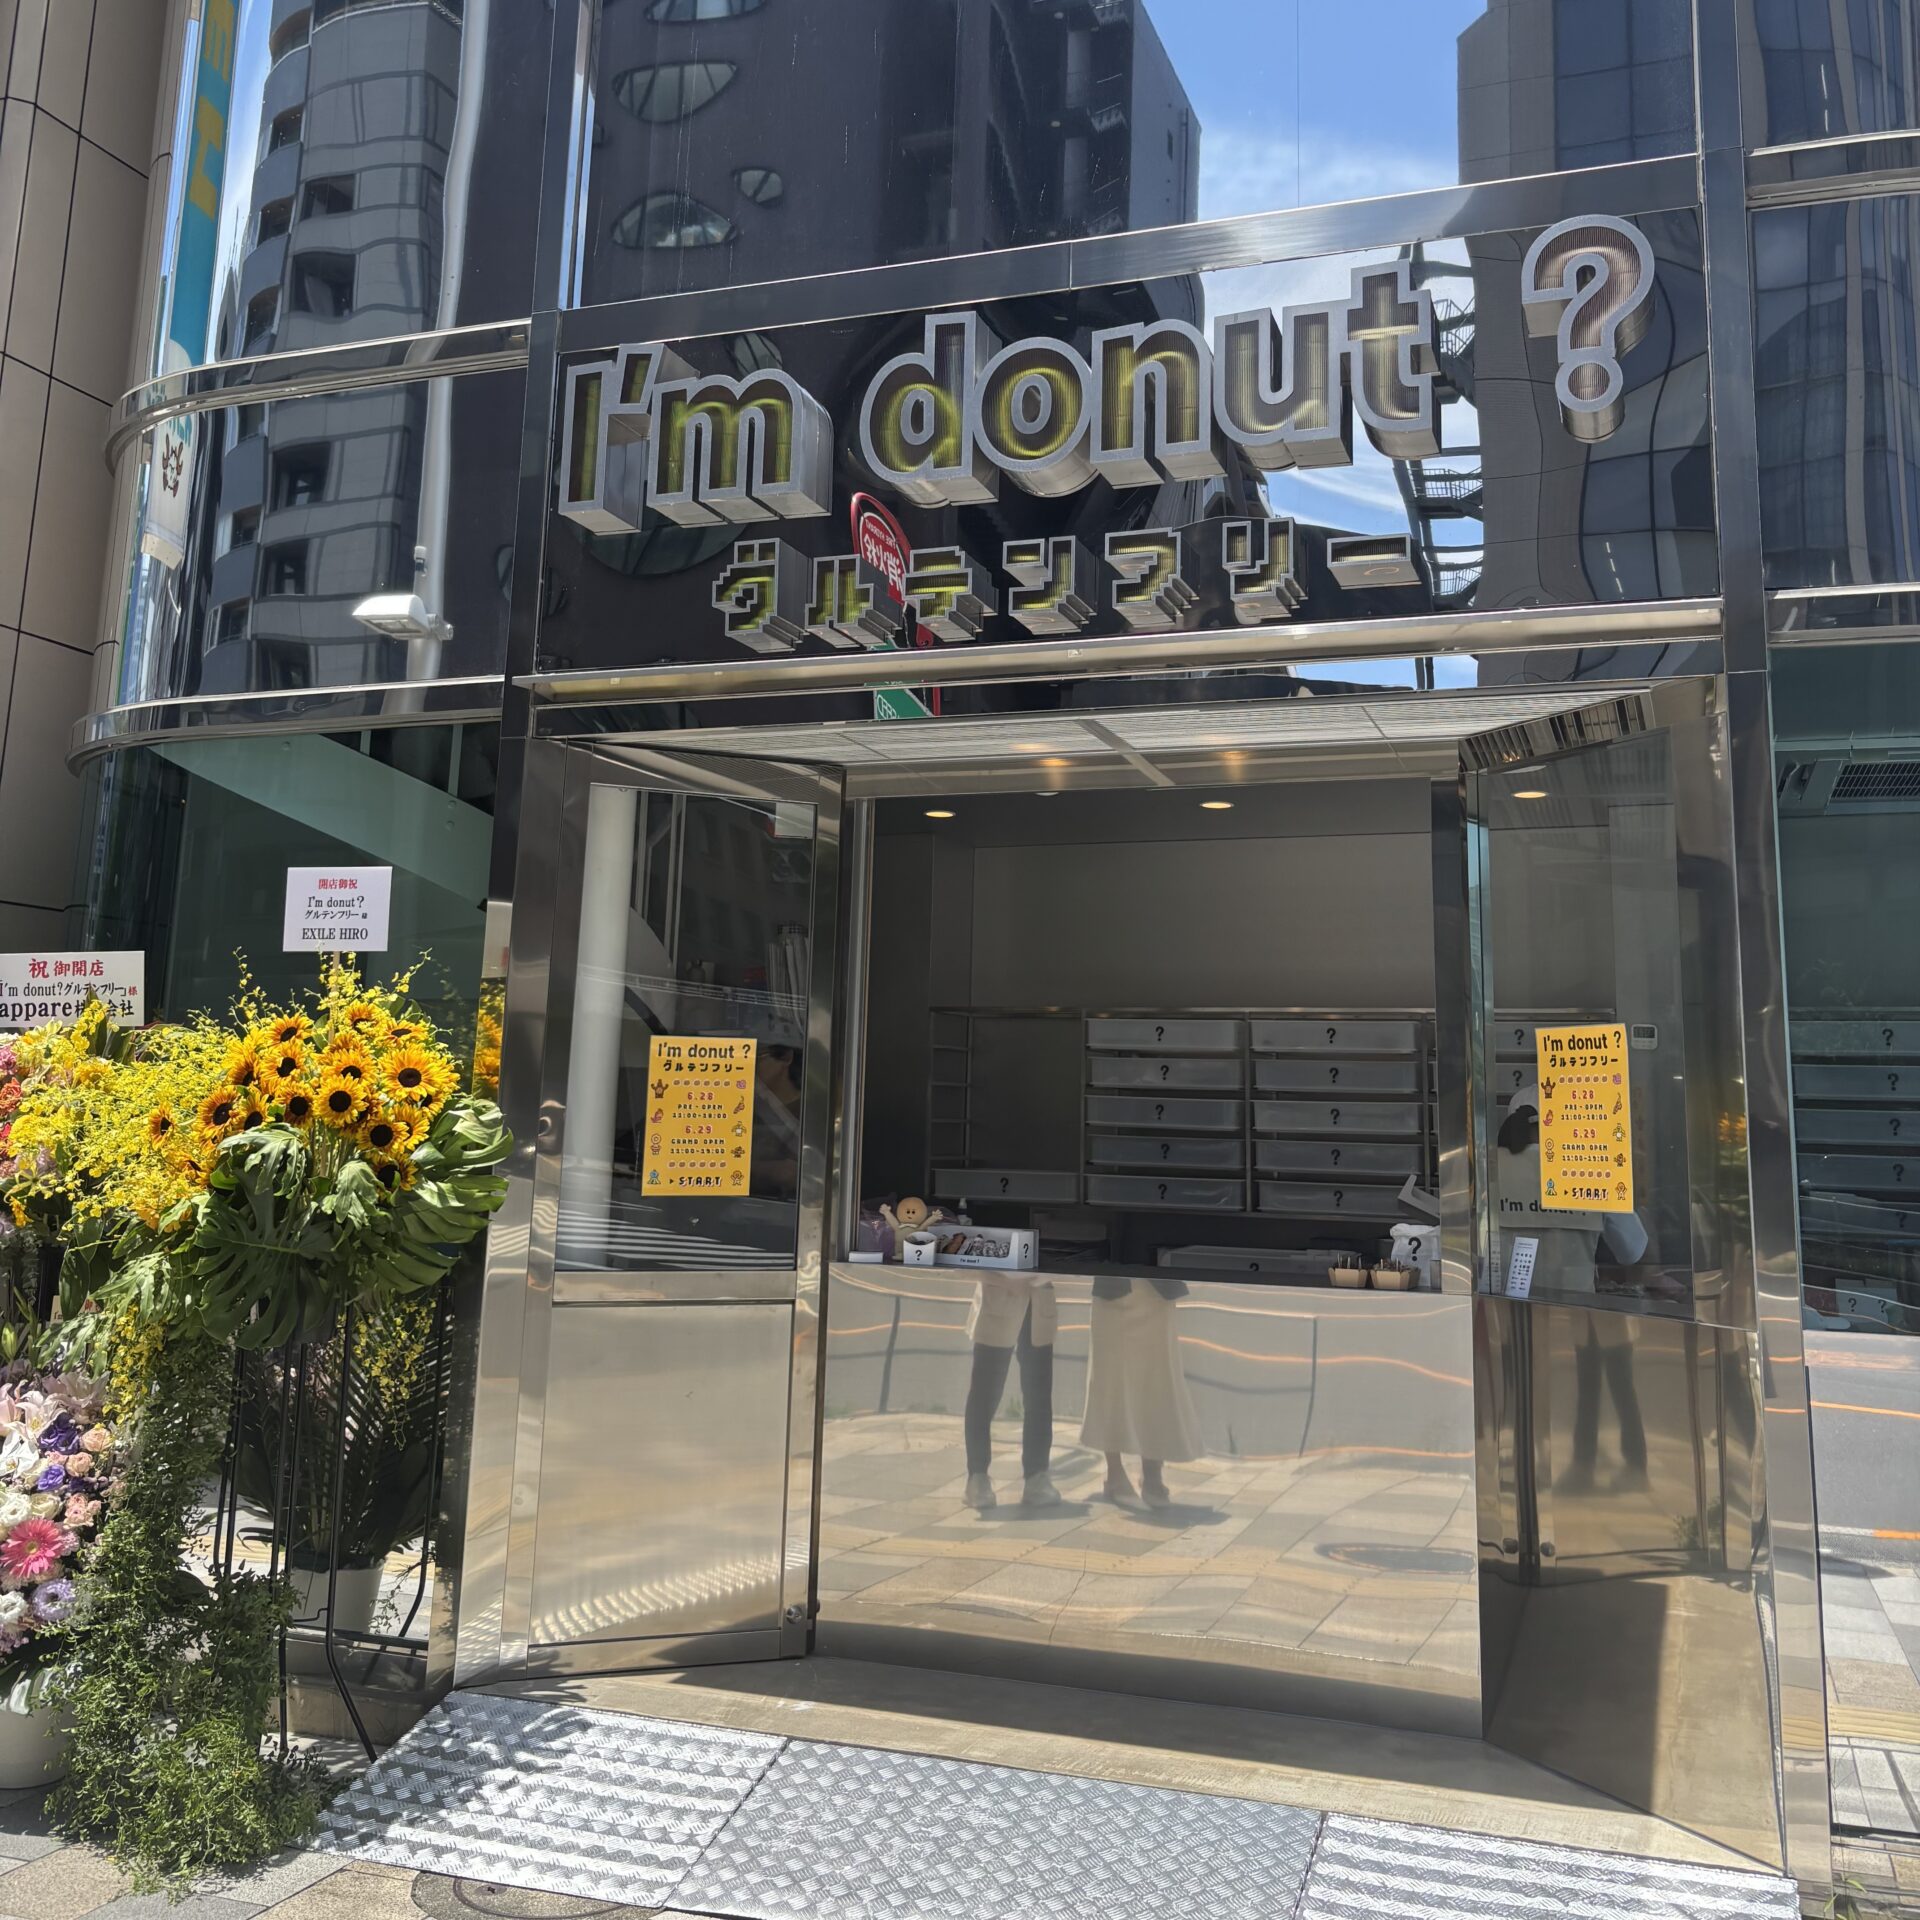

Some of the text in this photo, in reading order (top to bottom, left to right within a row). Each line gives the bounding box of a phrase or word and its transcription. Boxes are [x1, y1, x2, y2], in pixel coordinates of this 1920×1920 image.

[558, 213, 1655, 516] I'm donut ?
[712, 517, 1412, 638] グルテンフリー
[318, 878, 358, 890] 開店御祝
[304, 909, 359, 920] グルテンフリー
[301, 927, 369, 940] EXILE HIRO
[1543, 1030, 1622, 1052] I'm donut ?
[658, 1042, 751, 1059] I'm donut ?
[663, 1060, 745, 1073] グルテンフリー
[1549, 1054, 1619, 1068] グルテンフリー
[1571, 1090, 1595, 1100] 6.28
[685, 1125, 713, 1135] 6.29
[1573, 1128, 1597, 1139] 6.29
[679, 1176, 722, 1186] START
[1572, 1187, 1609, 1200] START
[1500, 1197, 1524, 1212] I'm
